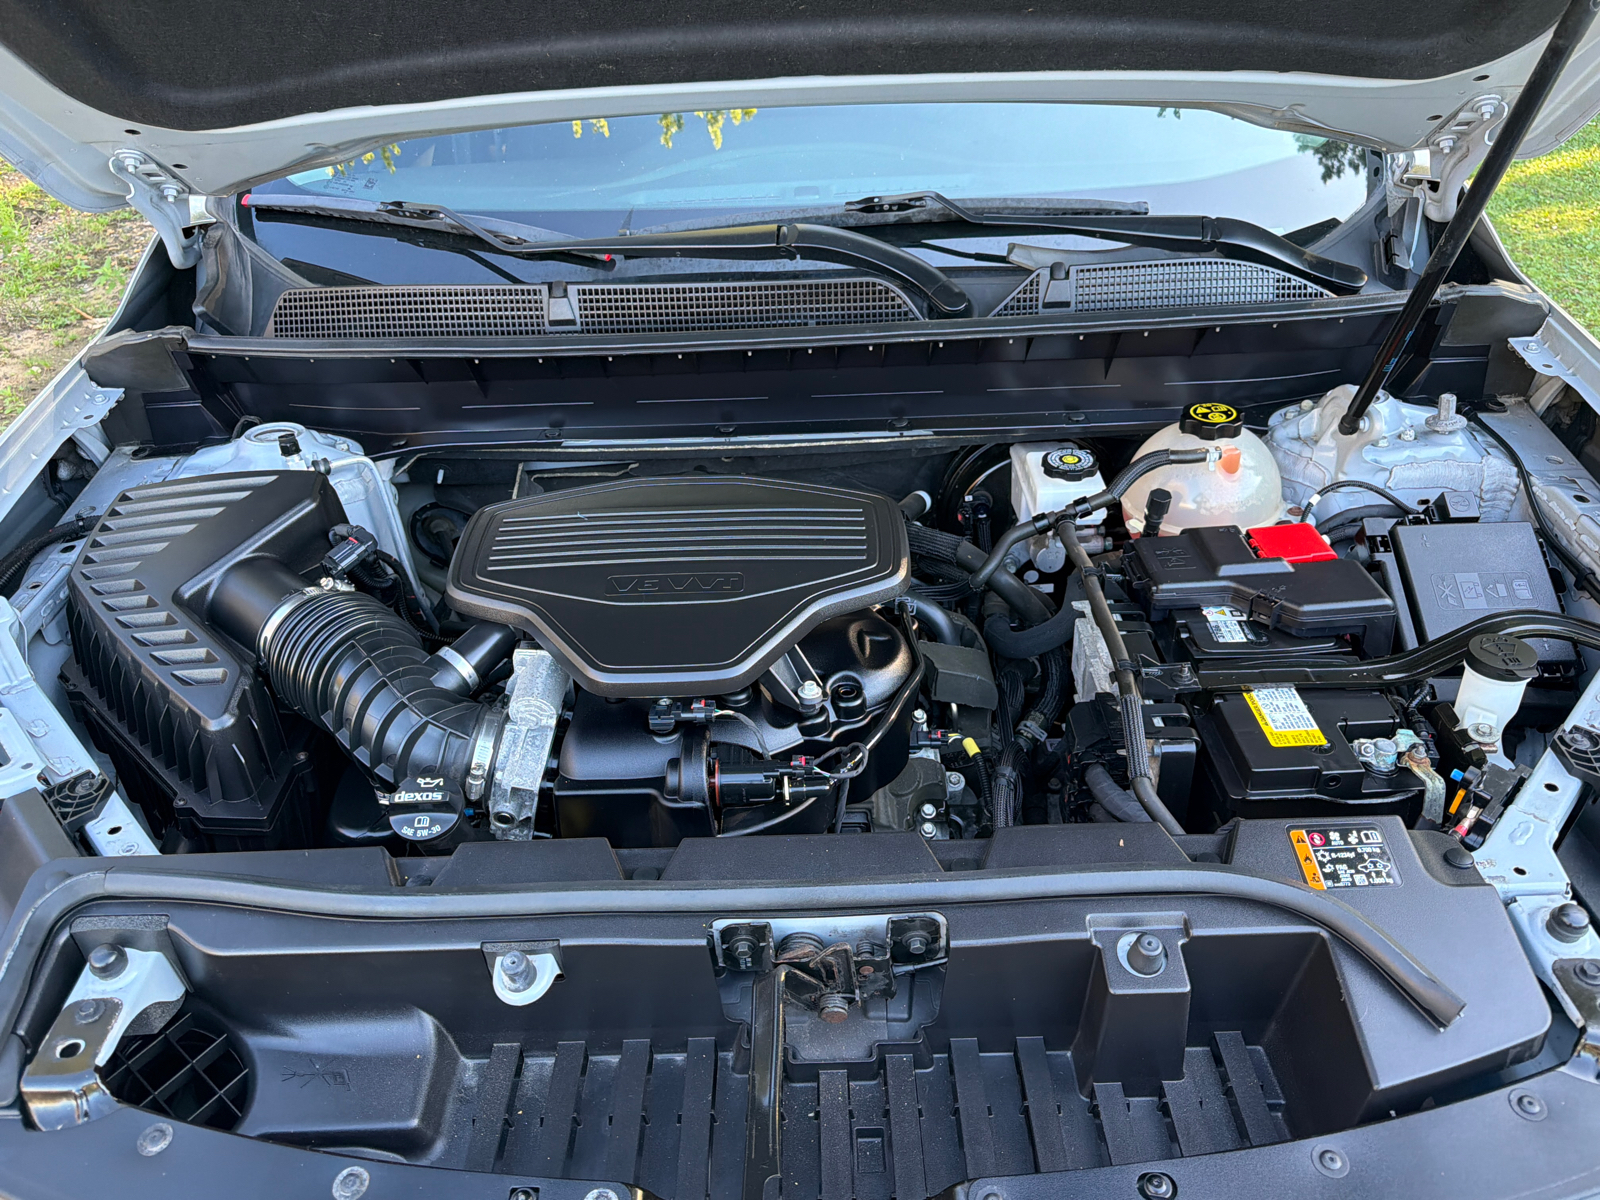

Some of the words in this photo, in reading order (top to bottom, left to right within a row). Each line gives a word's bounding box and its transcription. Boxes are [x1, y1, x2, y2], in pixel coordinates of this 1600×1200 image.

[667, 576, 739, 590] VVT
[394, 790, 443, 802] dexos
[401, 825, 415, 836] SAE
[416, 824, 442, 837] 5W-30
